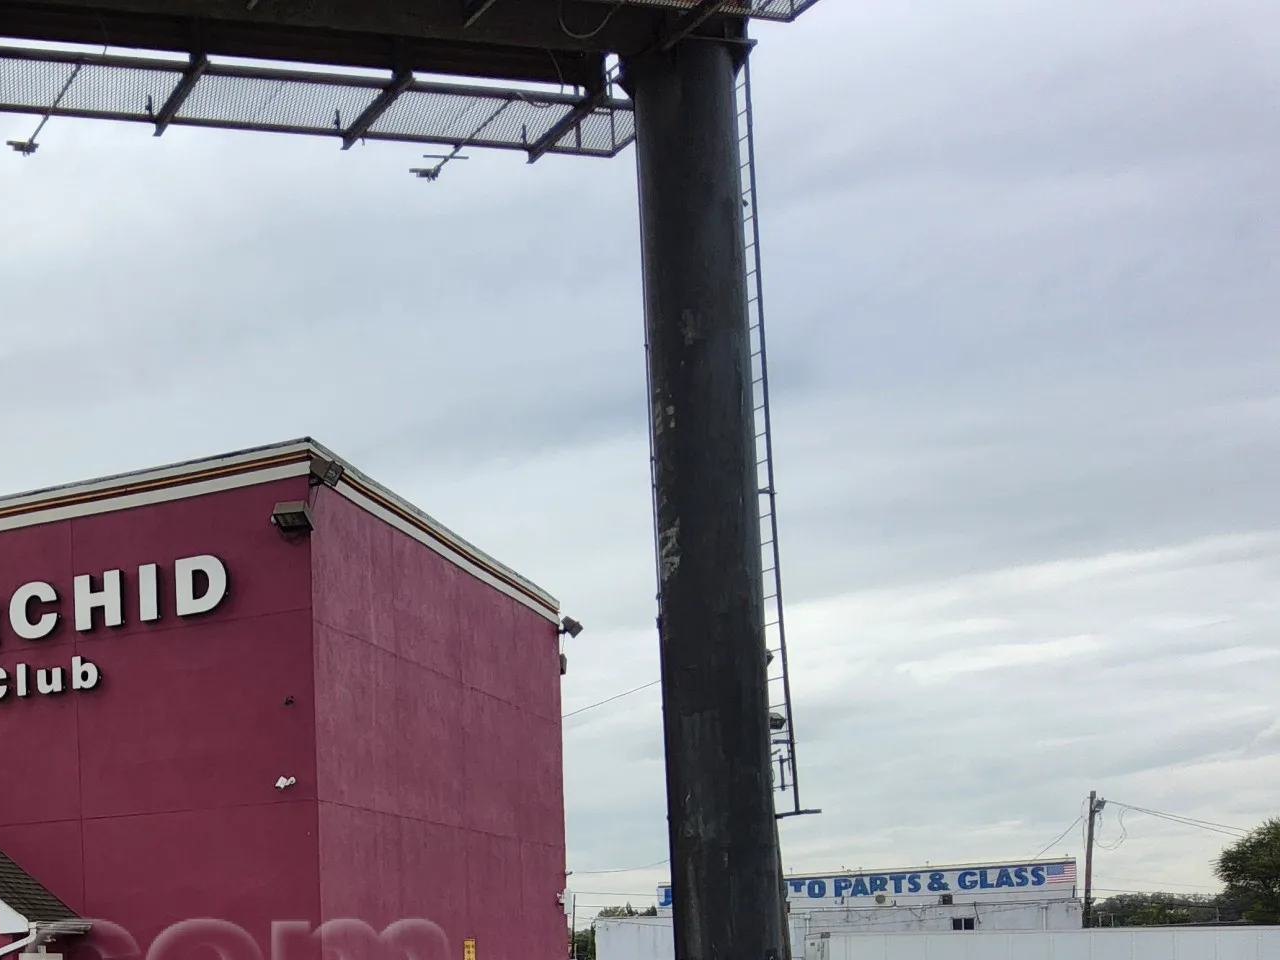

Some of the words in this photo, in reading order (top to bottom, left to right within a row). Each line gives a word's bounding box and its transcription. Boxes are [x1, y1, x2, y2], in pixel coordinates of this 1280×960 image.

[783, 879, 826, 898] TO
[834, 873, 921, 898] PARTS
[927, 872, 950, 891] &
[958, 866, 1046, 890] GLASS
